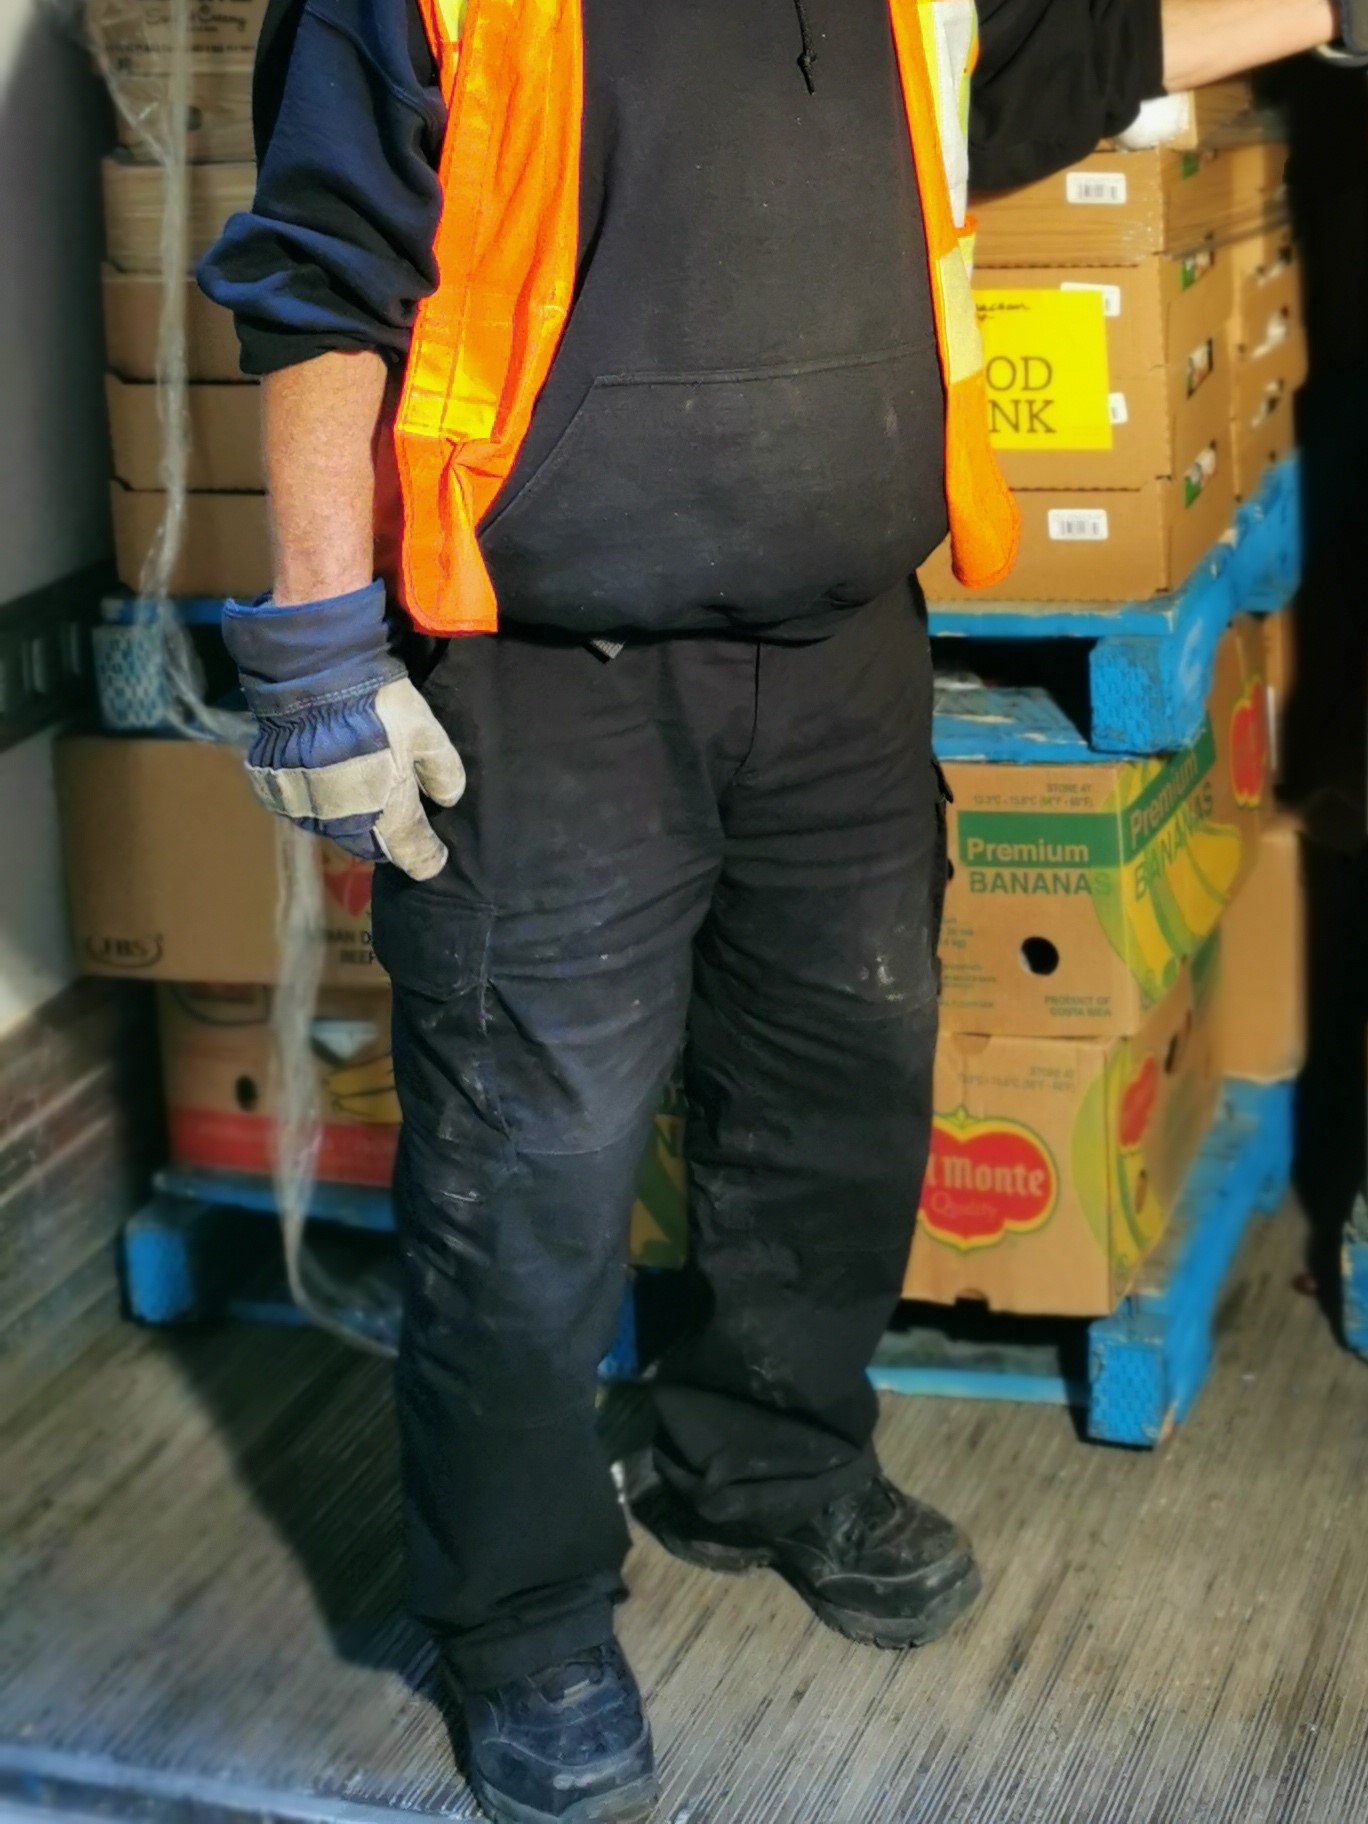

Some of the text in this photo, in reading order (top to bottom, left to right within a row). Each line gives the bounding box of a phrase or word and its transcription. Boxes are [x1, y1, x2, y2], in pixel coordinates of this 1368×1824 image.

[985, 354, 1054, 393] OD
[987, 398, 1057, 435] NK
[1130, 750, 1199, 850] Premium
[966, 836, 1089, 863] Premium
[968, 869, 1112, 896] BANANAS
[1044, 995, 1095, 1007] PRODUCT
[942, 1154, 1046, 1197] Monte
